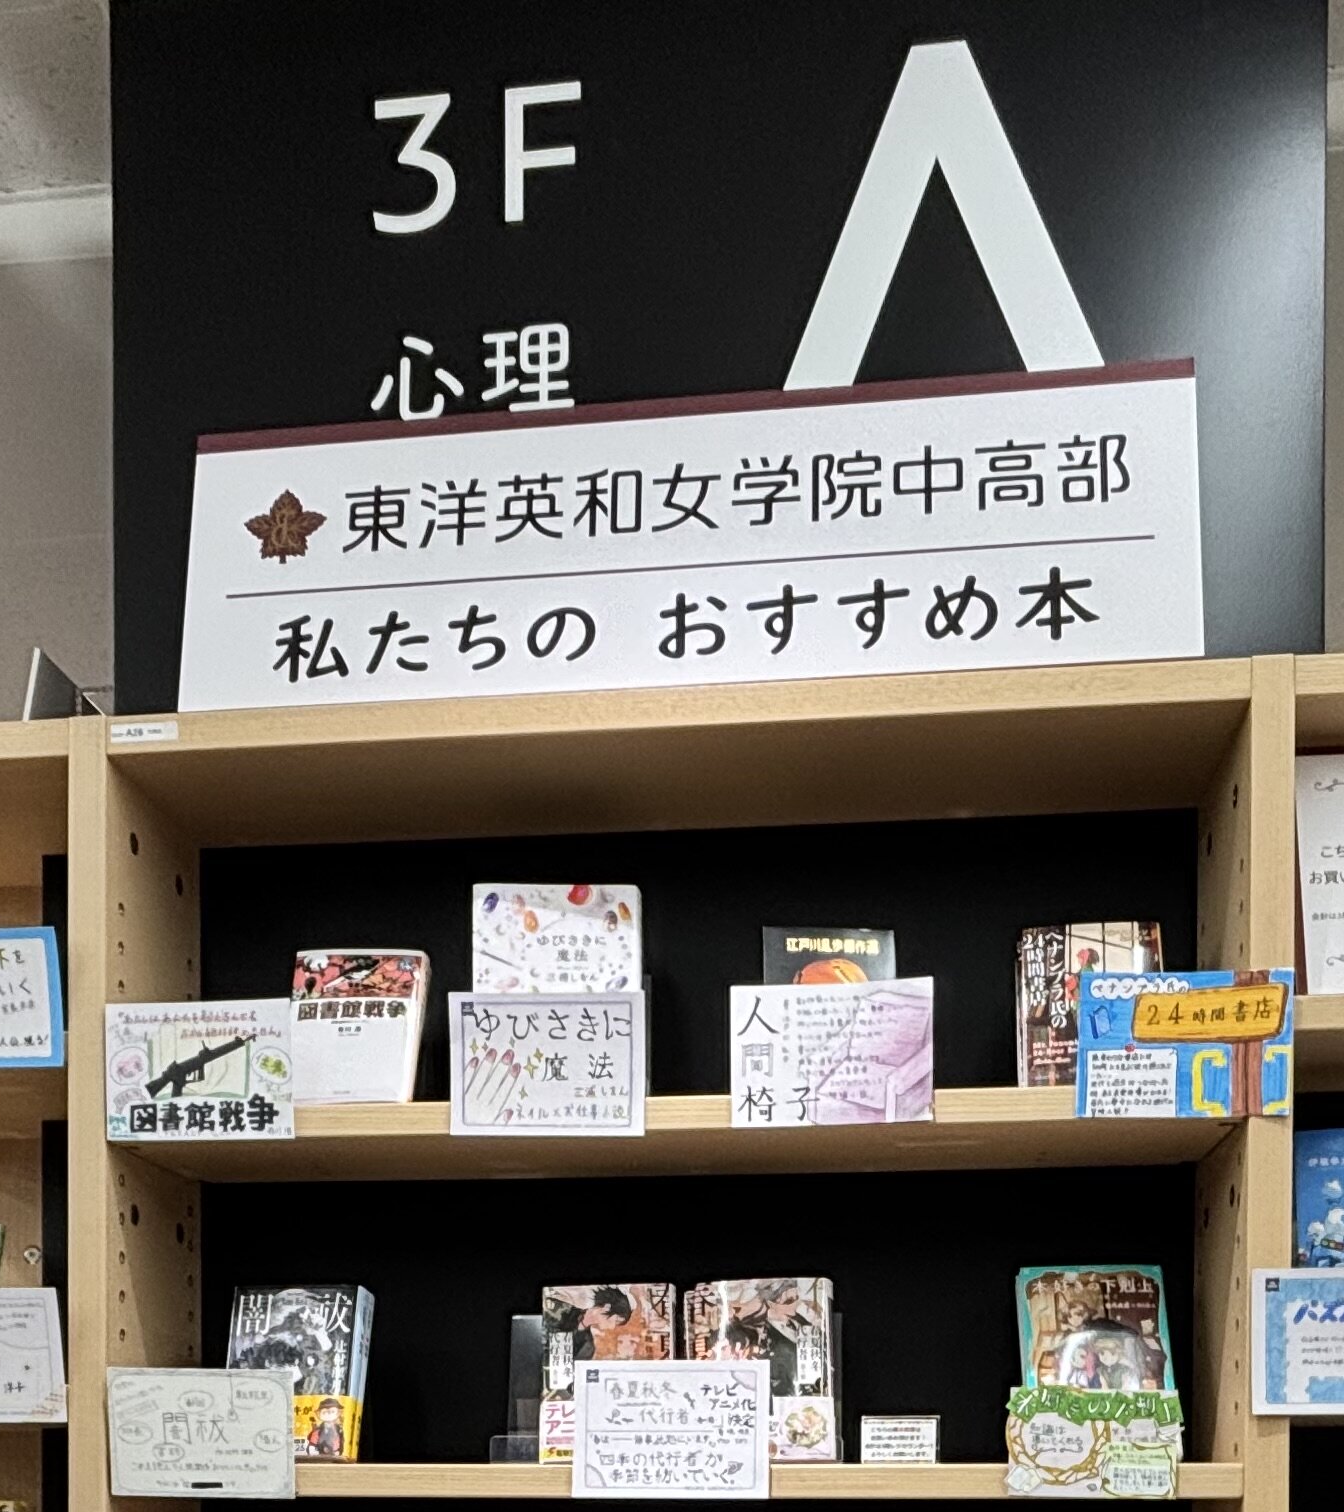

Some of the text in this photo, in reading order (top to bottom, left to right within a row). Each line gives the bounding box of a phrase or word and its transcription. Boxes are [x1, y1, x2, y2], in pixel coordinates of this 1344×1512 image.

[371, 81, 582, 235] 3F
[371, 322, 576, 421] 心理
[342, 434, 1132, 554] 東洋英和女学院中高部
[273, 565, 1102, 683] 私たちの おすすめ本
[536, 933, 607, 948] ゆびさきに
[556, 949, 589, 963] 魔法
[296, 1000, 407, 1022] 図書館戦争
[473, 1007, 632, 1042] ゆびさきに
[540, 1052, 614, 1082] 魔法
[130, 1093, 280, 1134] 図書館戦争
